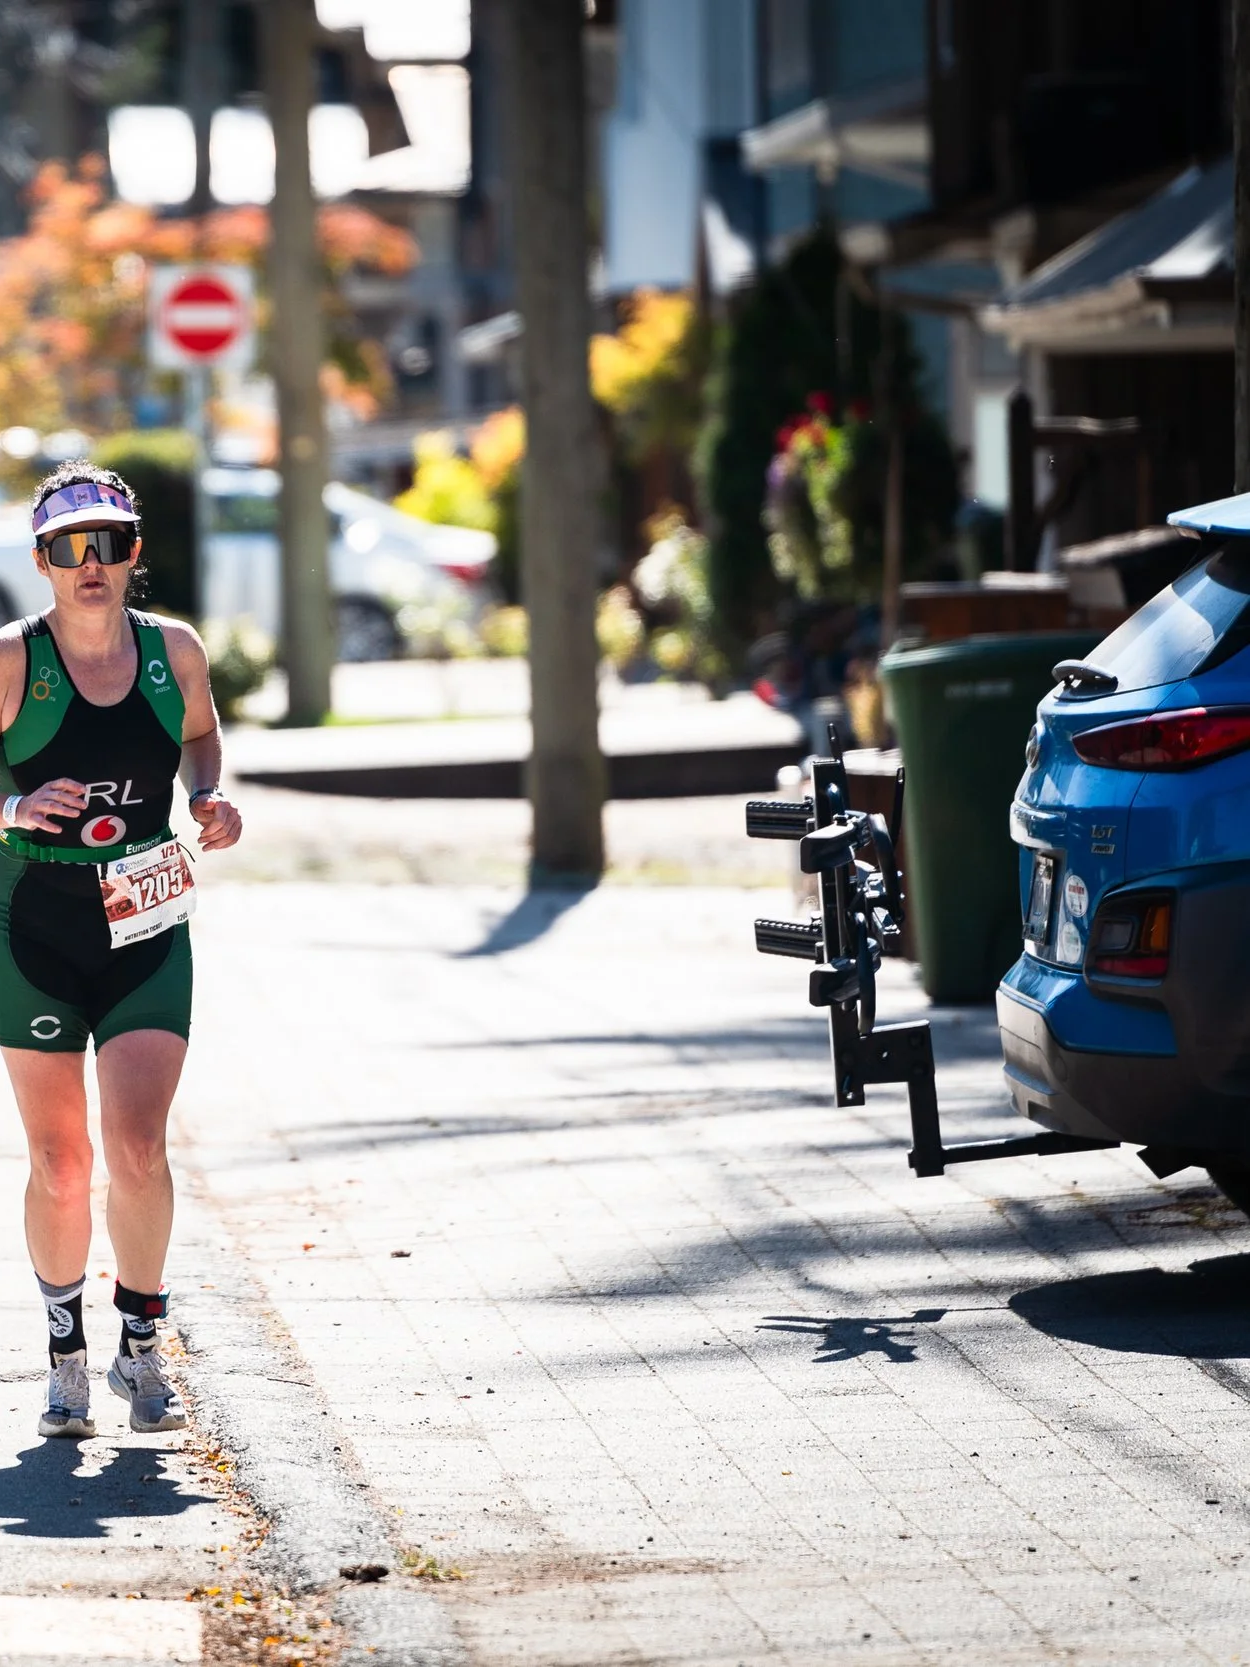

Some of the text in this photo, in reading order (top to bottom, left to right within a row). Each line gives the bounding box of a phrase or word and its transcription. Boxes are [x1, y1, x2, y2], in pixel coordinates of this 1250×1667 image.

[84, 779, 143, 806] RL
[126, 836, 162, 854] Europcar
[129, 865, 183, 912] 1205
